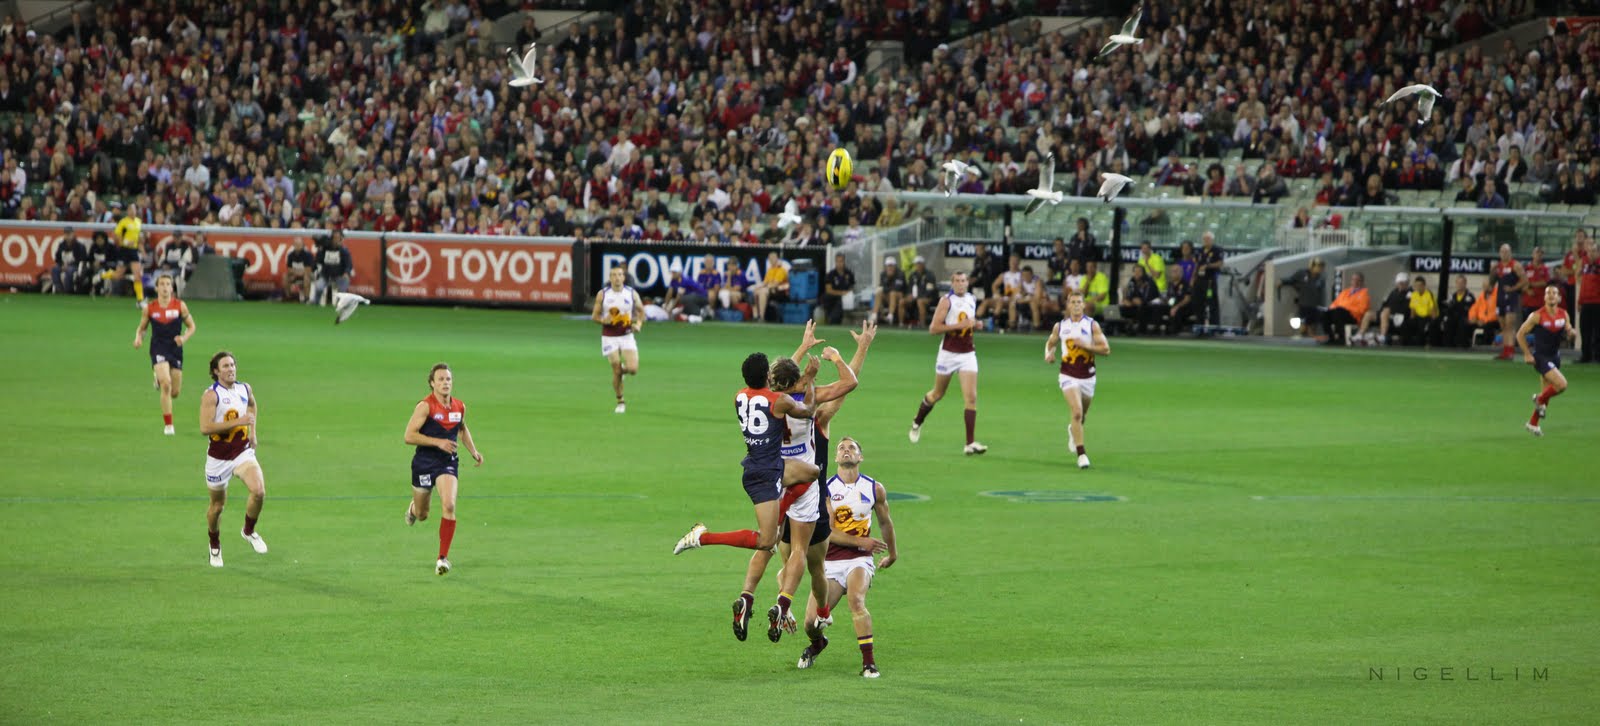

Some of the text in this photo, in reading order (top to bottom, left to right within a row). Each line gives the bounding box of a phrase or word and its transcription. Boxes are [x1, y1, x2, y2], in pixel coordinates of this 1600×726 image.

[440, 248, 572, 284] TOYOTA
[1415, 257, 1484, 271] POWRADE
[736, 393, 769, 435] 36
